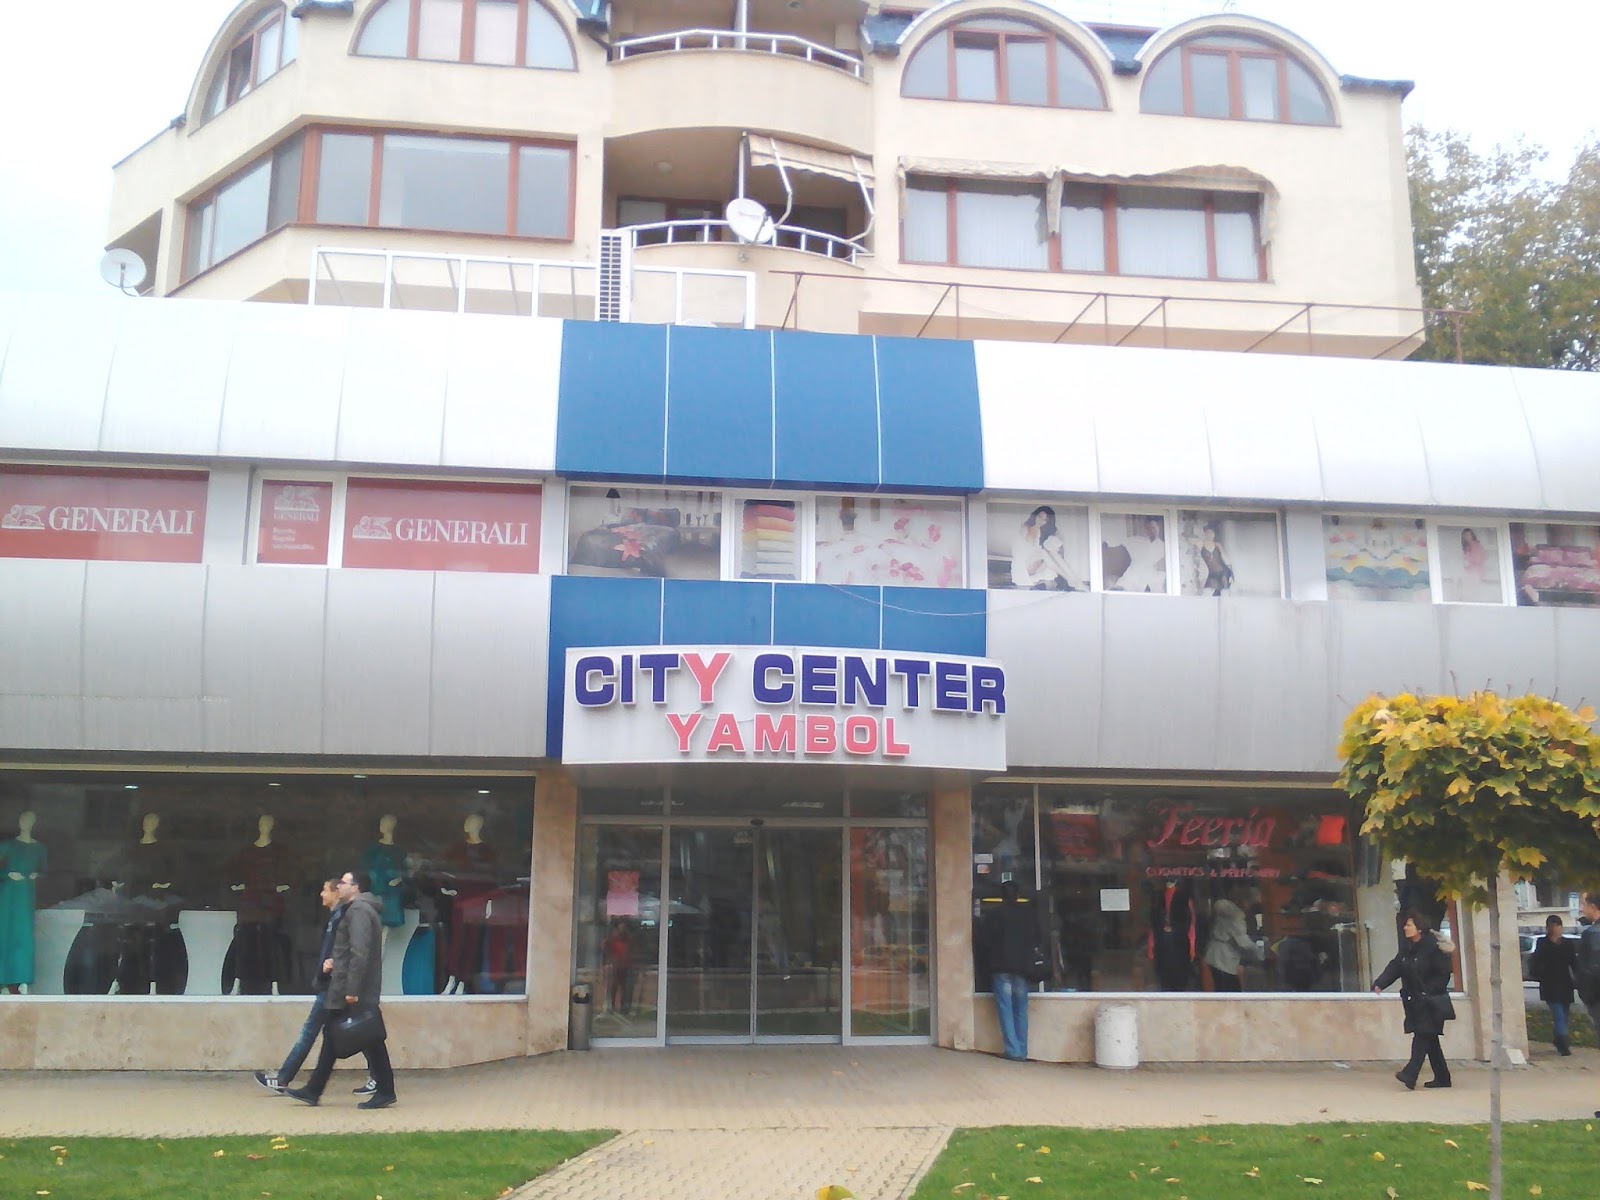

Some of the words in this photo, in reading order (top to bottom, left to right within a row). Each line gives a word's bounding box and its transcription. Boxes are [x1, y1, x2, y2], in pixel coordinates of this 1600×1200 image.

[48, 506, 195, 535] GENERALI
[395, 517, 528, 546] GENERALI
[574, 652, 732, 708] CITY
[752, 652, 1007, 715] CENTER
[666, 712, 912, 757] YAMBOL
